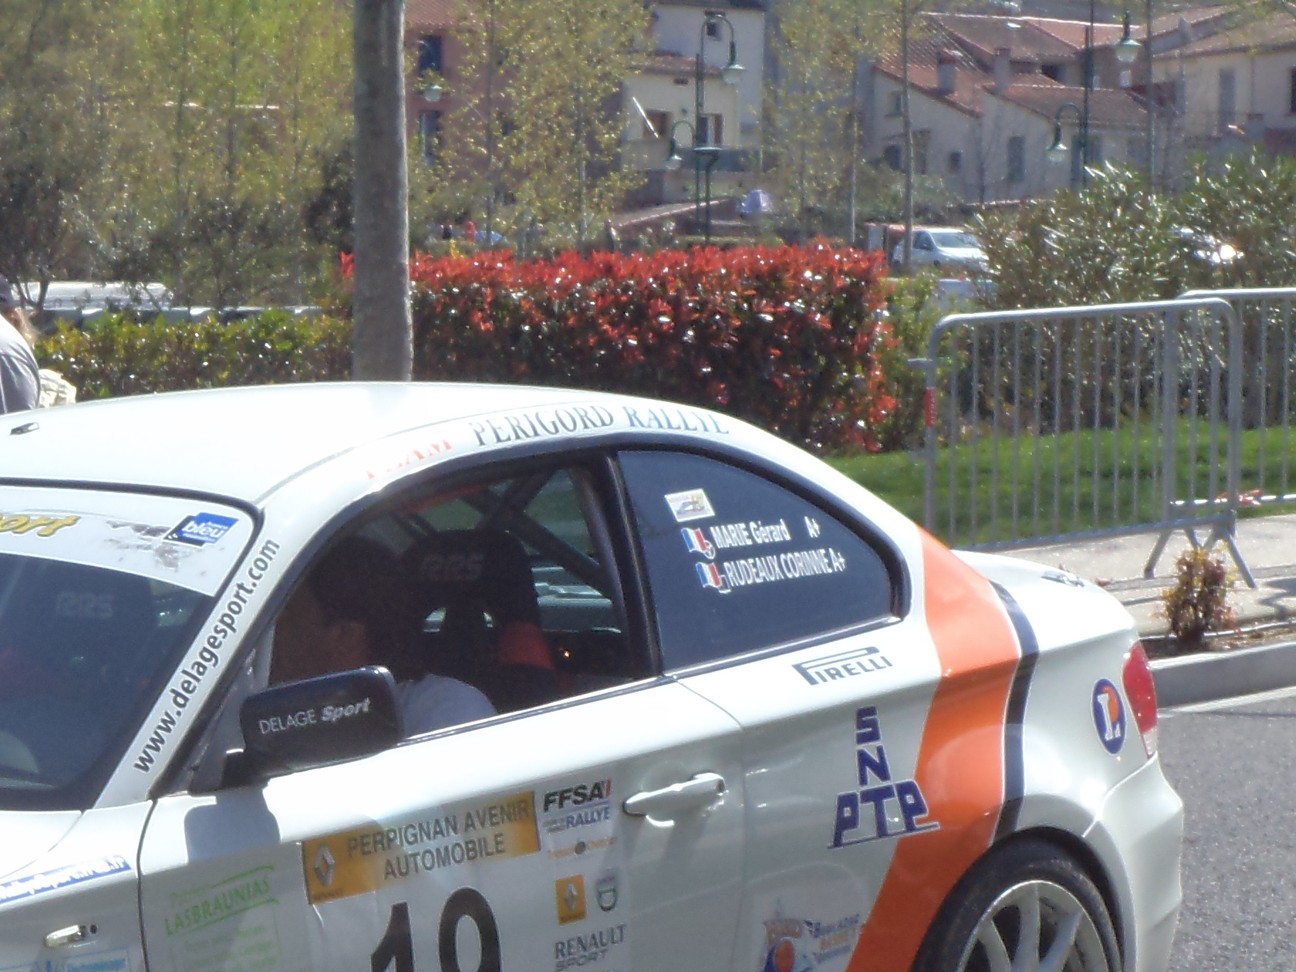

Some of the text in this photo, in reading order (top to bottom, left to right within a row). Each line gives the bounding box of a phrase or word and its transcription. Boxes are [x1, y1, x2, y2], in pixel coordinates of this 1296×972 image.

[181, 519, 225, 539] bleu
[710, 524, 753, 549] MARIE
[723, 558, 785, 587] RUDEAUX
[134, 537, 281, 774] www.delagesport.com
[792, 646, 894, 686] PIRELLI
[259, 697, 371, 735] DELAGE Sport
[543, 780, 605, 813] FFSA
[347, 814, 459, 859] PERPIGNAN
[463, 799, 531, 832] AVENIR
[565, 805, 612, 829] RALLYE
[383, 833, 507, 881] AUTOMOBILE
[555, 924, 627, 960] RENAULT
